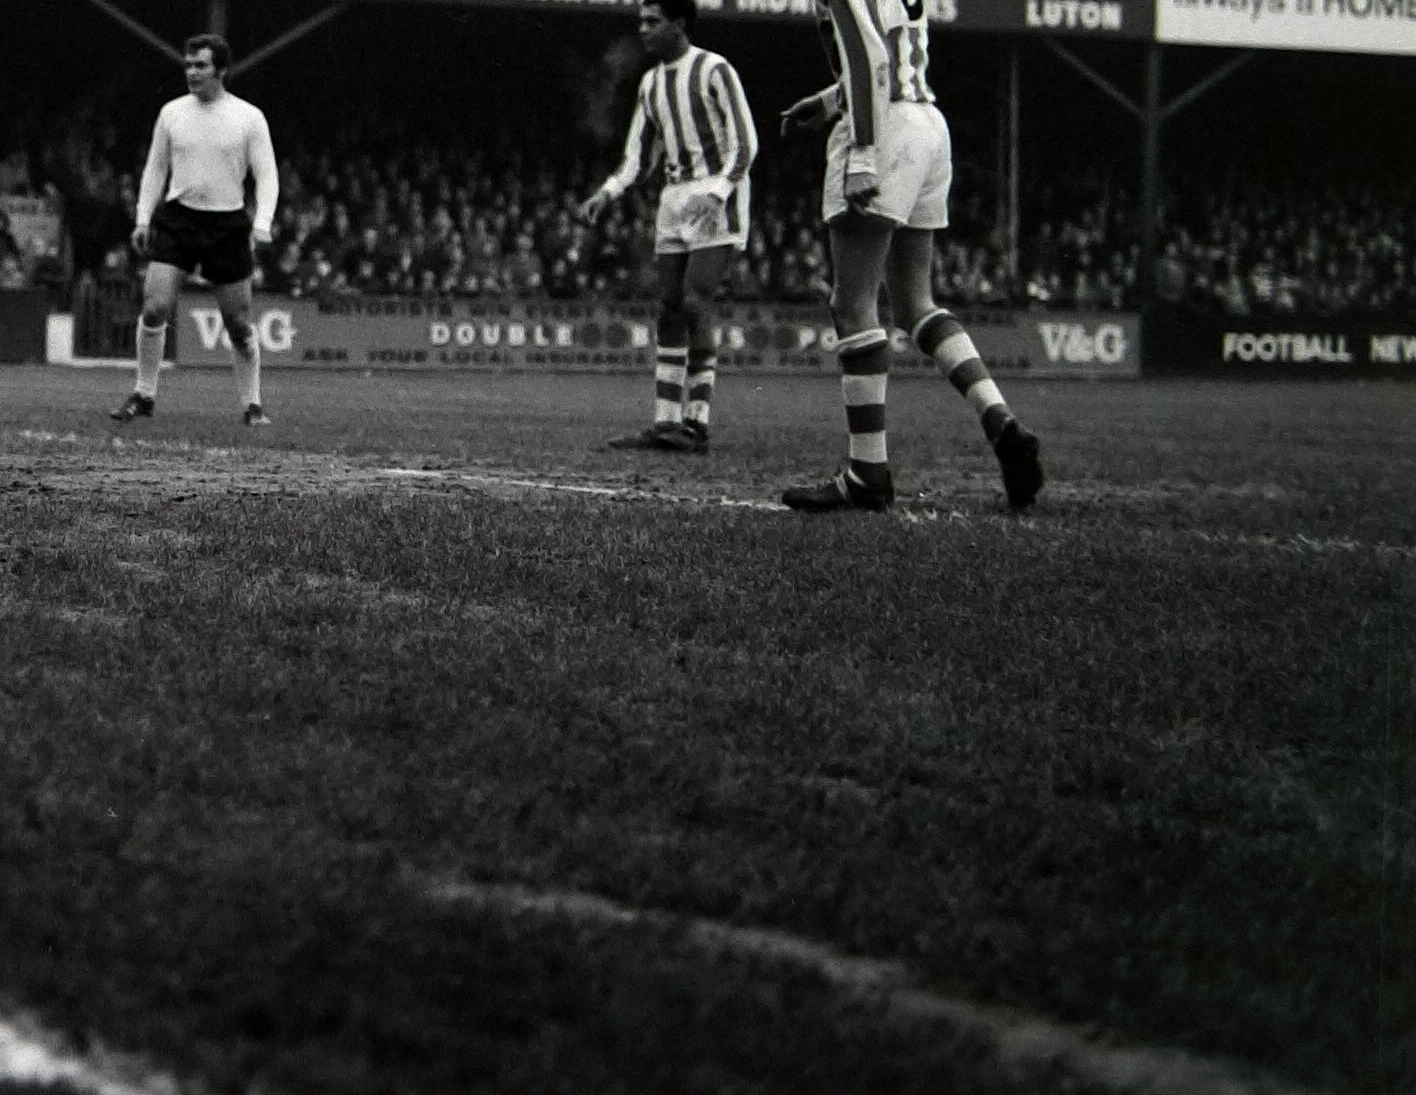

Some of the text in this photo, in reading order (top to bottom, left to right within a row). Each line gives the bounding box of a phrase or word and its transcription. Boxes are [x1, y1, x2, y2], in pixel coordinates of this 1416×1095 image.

[431, 321, 573, 347] DOUBLE
[1037, 322, 1128, 363] V&G
[1223, 331, 1355, 363] FOOTBALL
